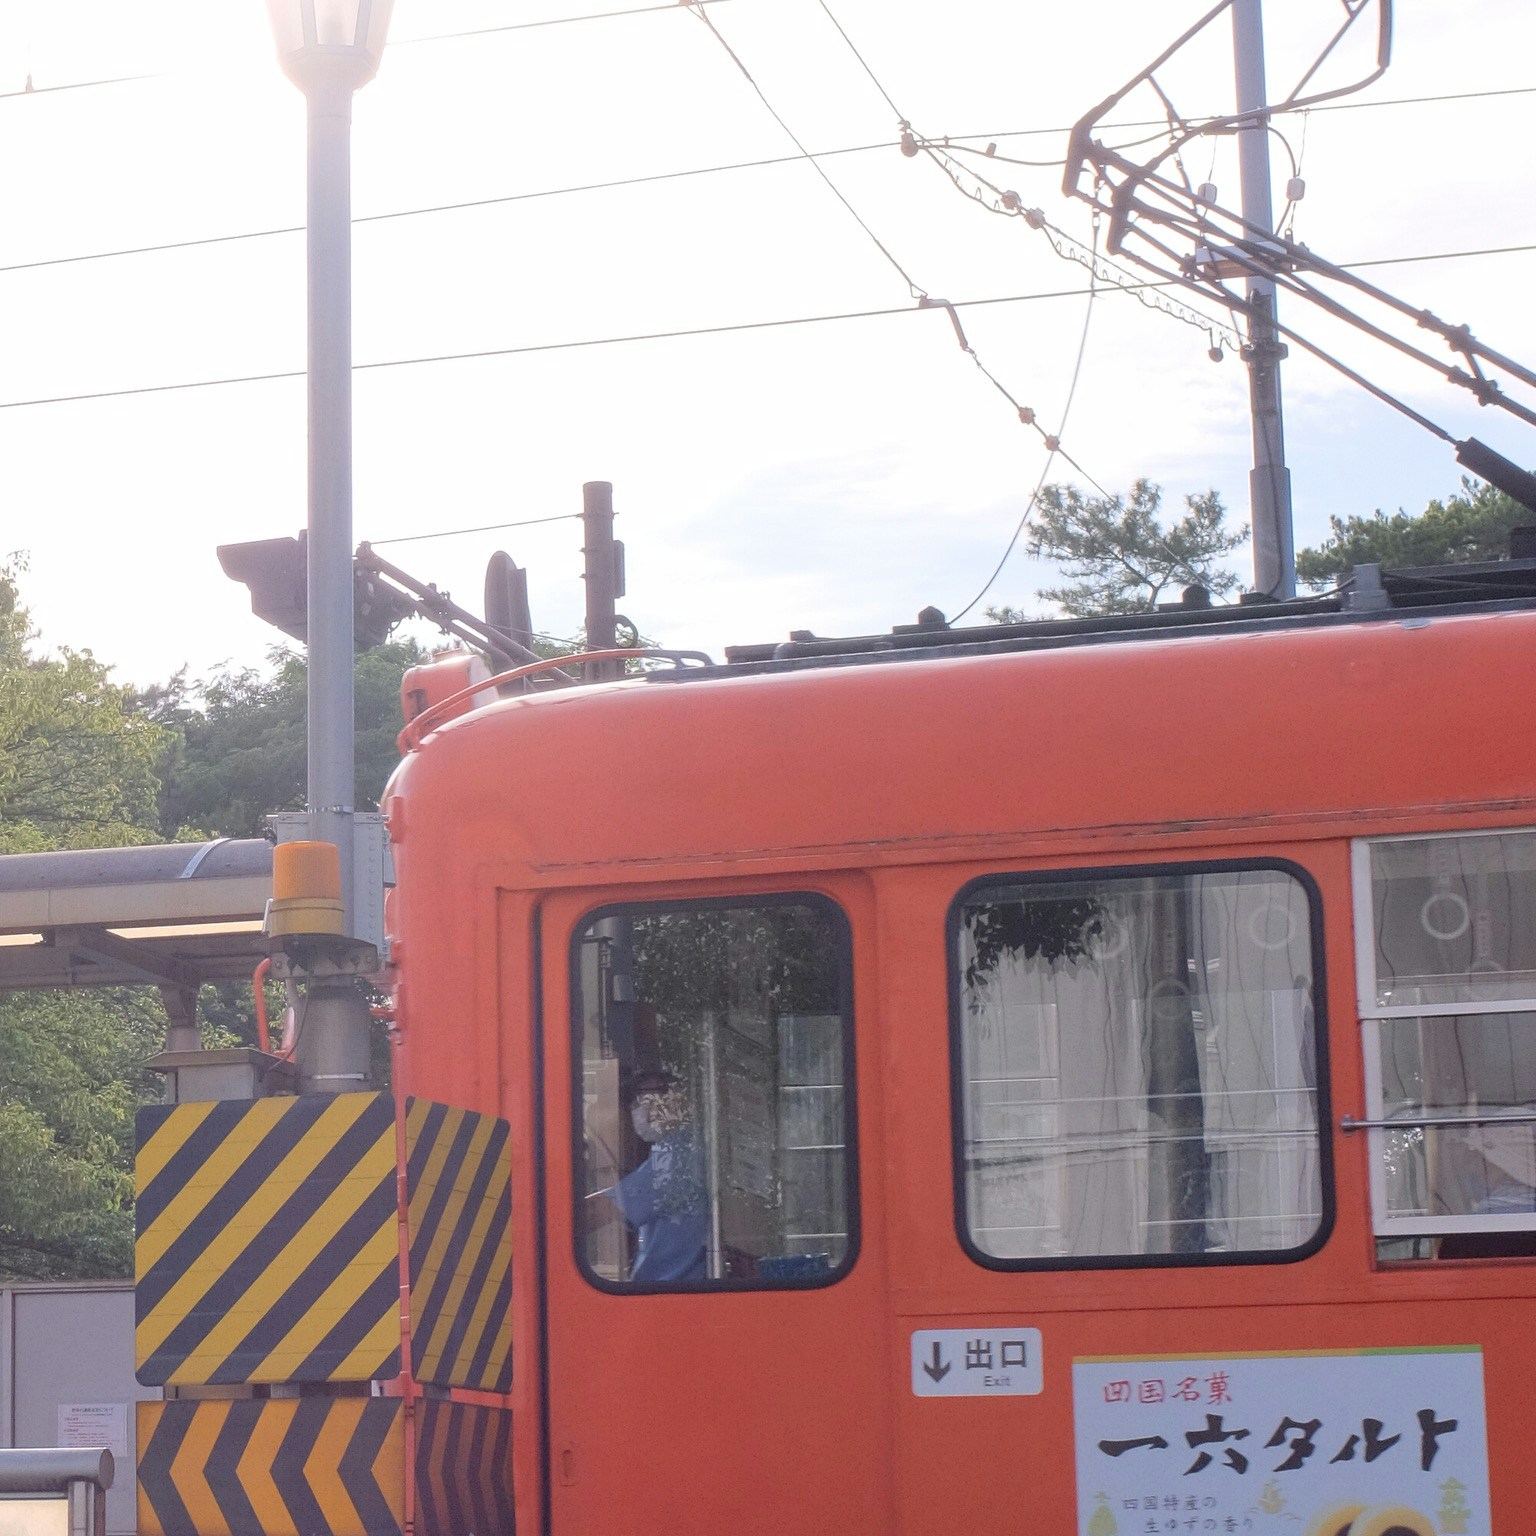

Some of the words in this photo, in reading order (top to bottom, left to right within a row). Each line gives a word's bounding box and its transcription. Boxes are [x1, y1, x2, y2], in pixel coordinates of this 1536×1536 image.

[966, 1339, 1027, 1370] 出口
[984, 1375, 1011, 1387] Exit
[1103, 1370, 1232, 1405] 四国名菓
[1098, 1408, 1458, 1475] 一六タルト
[1122, 1494, 1216, 1511] 四国特産の
